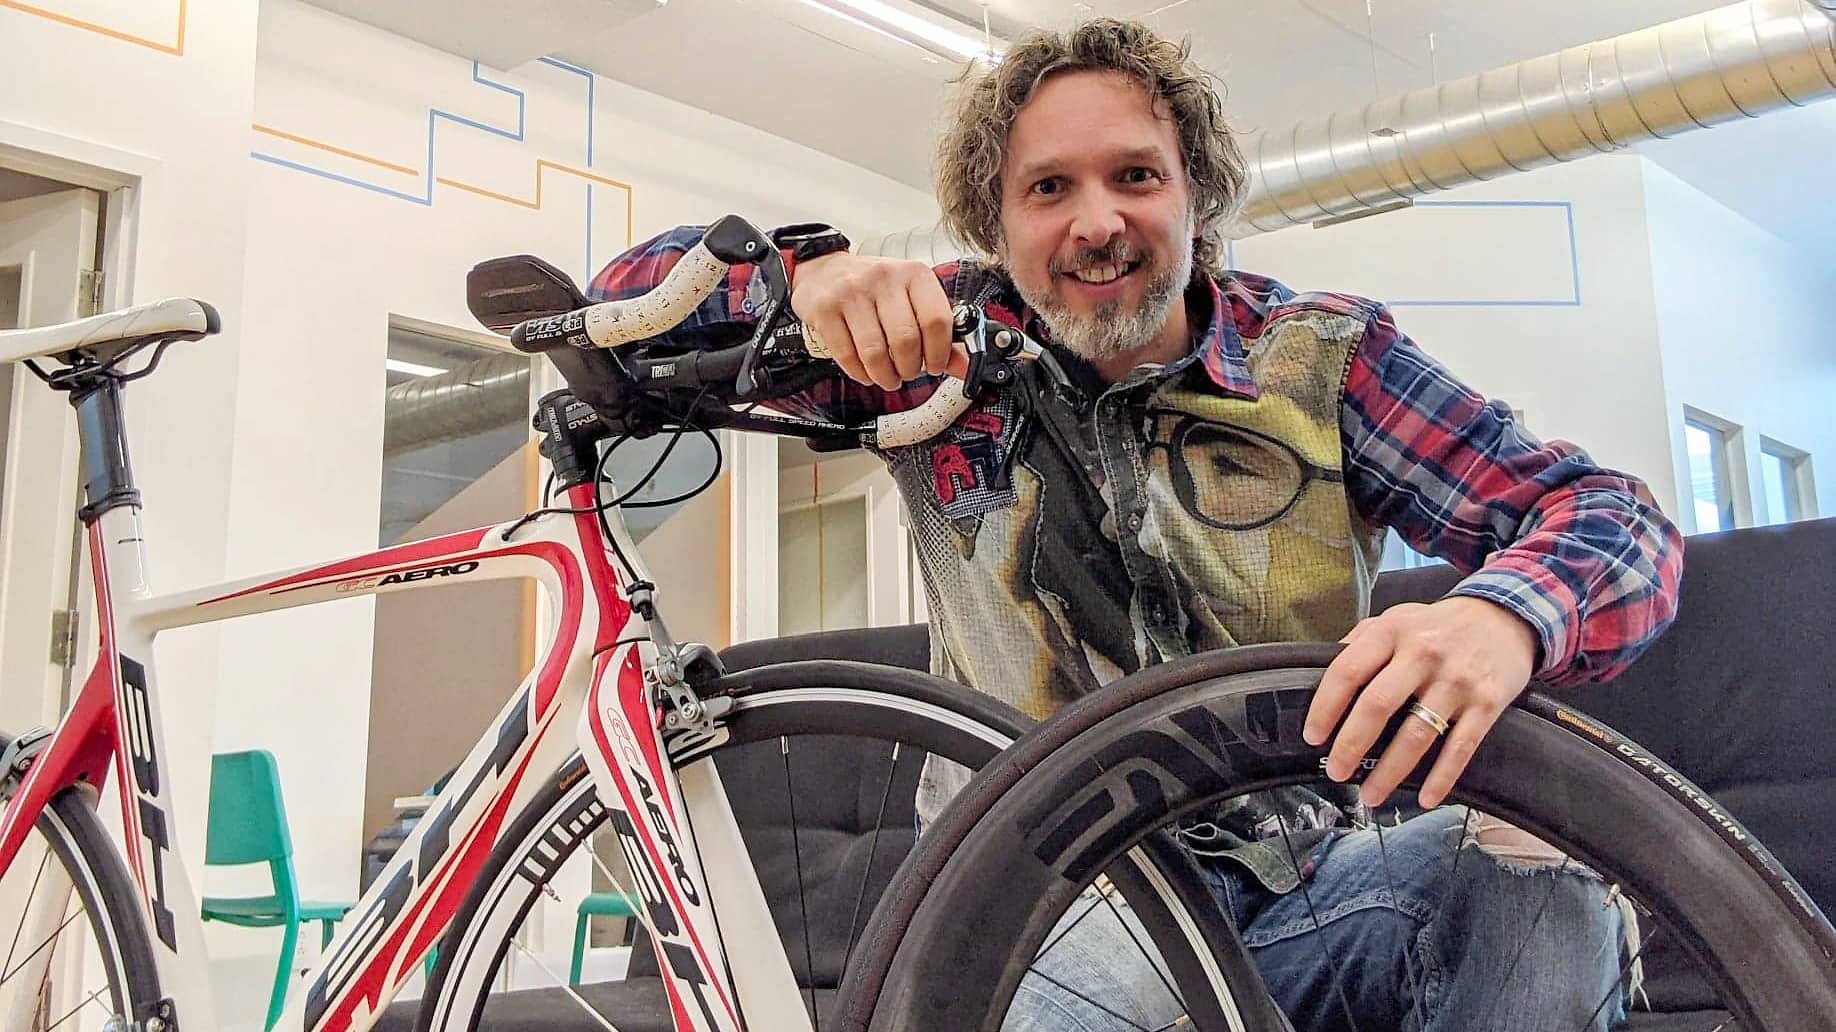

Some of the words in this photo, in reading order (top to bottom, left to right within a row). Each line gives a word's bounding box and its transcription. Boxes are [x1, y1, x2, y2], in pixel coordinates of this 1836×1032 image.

[377, 561, 479, 587] AERO
[630, 765, 701, 907] AERO
[1616, 743, 1747, 842] GATORSKIN
